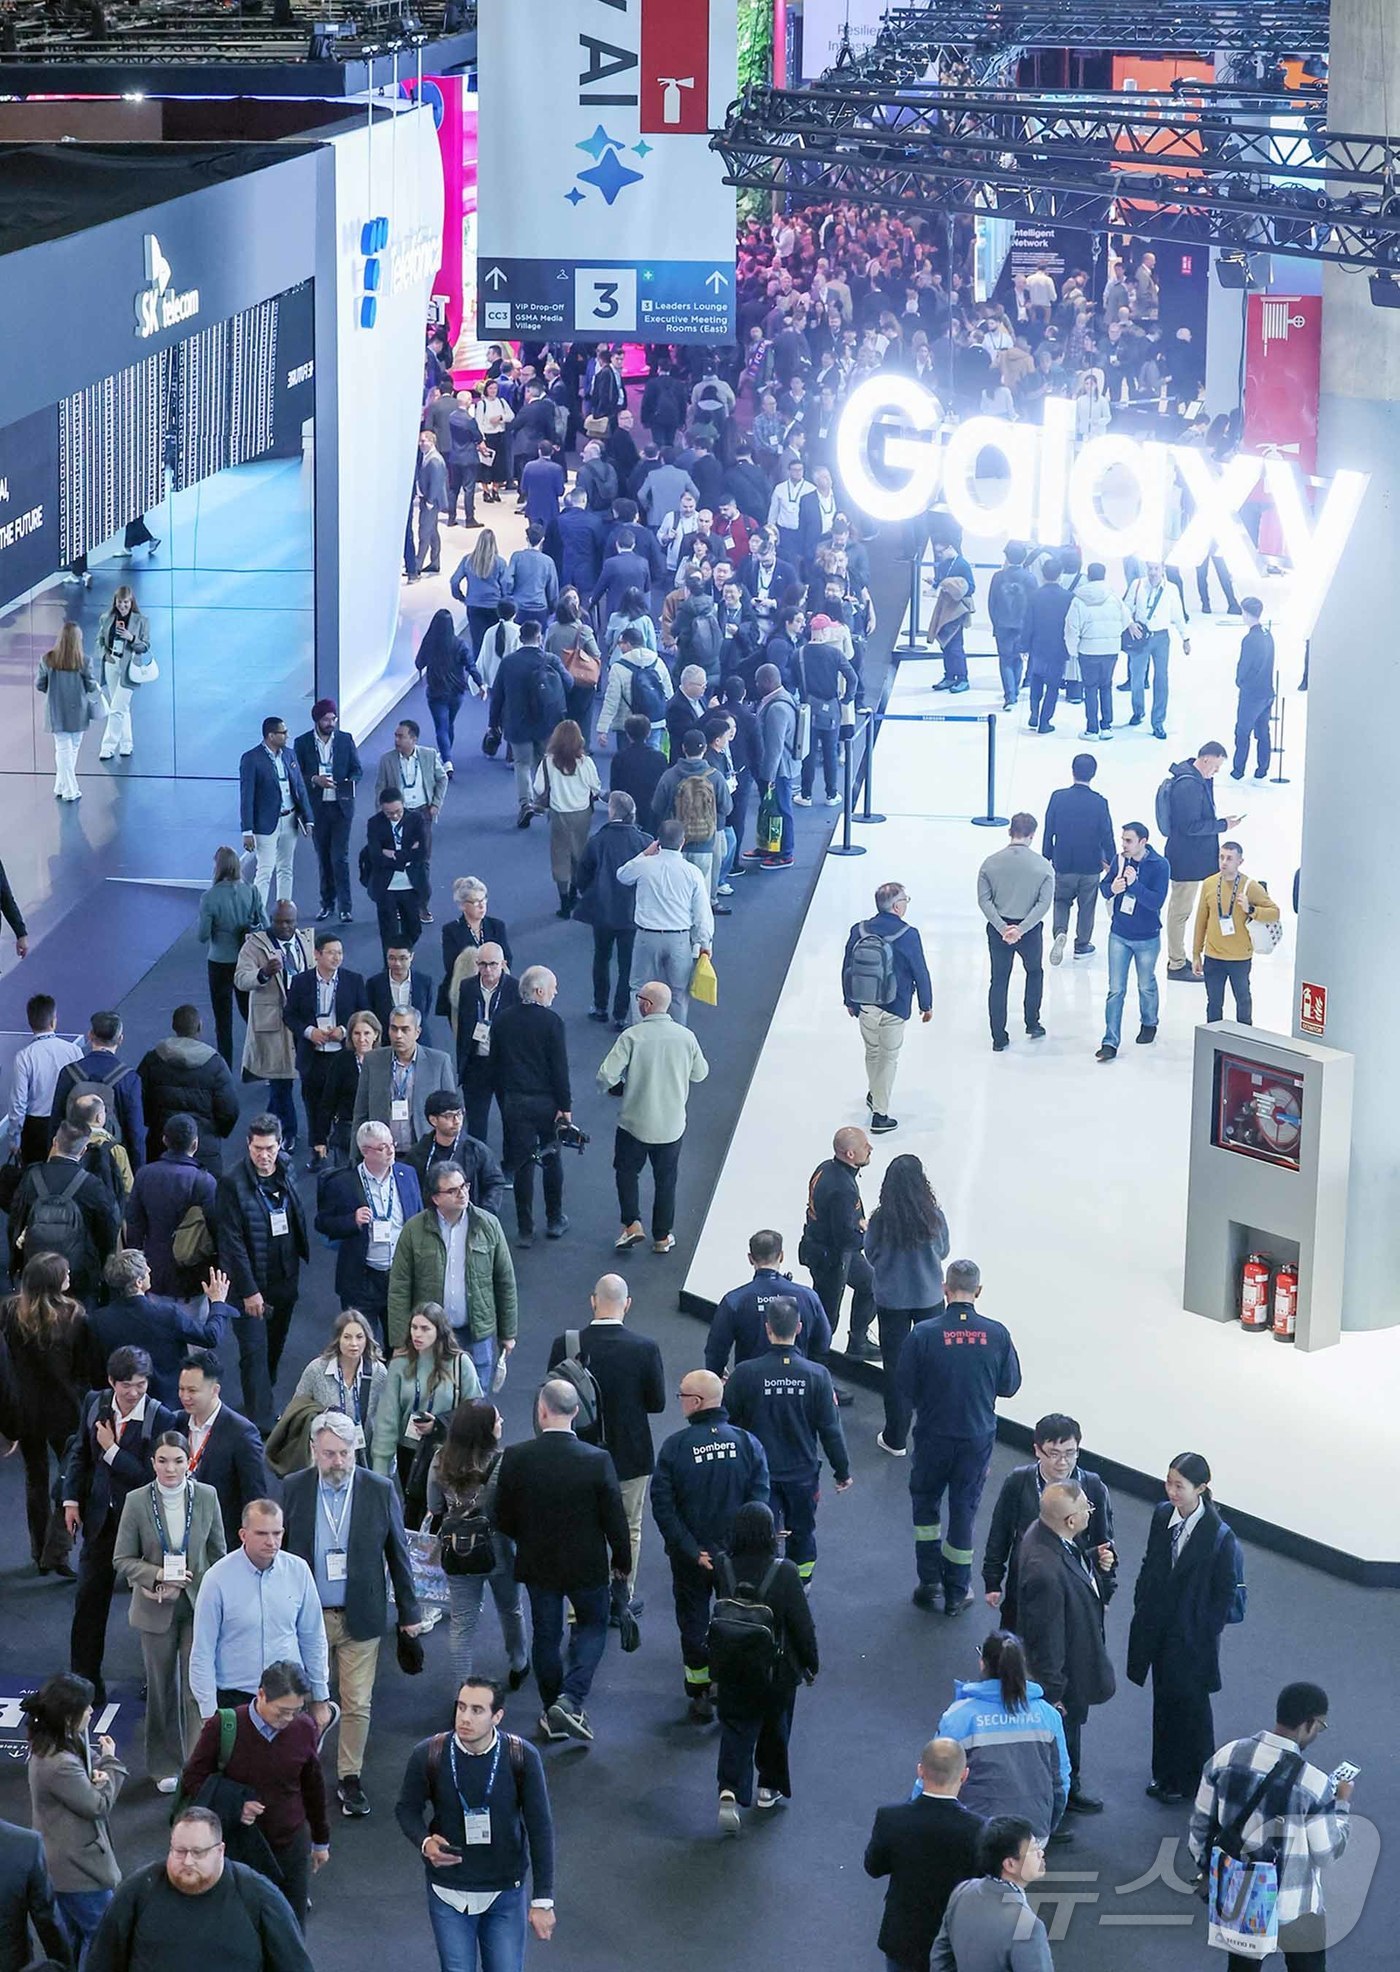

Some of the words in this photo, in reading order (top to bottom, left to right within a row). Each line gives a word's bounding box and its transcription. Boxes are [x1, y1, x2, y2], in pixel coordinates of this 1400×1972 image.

[579, 33, 638, 106] AI
[592, 282, 620, 320] 3
[515, 303, 529, 311] VIP
[531, 304, 565, 312] Drop-Off
[643, 302, 651, 311] 3
[655, 302, 691, 311] Leaders
[693, 303, 728, 313] Lounge
[138, 289, 159, 338] SK
[163, 289, 199, 328] telecom
[488, 311, 508, 320] CC3
[515, 314, 538, 322] GSMA
[540, 314, 563, 322] Media
[515, 322, 541, 330] Village
[644, 315, 689, 324] Executive
[691, 316, 728, 326] Meeting
[666, 325, 697, 333] Rooms
[699, 325, 728, 335] (East)
[836, 374, 1371, 641] Galaxy
[0, 522, 14, 549] THE
[15, 504, 43, 541] FUTURE
[943, 1330, 987, 1340] bombers
[764, 1378, 806, 1388] bombers
[692, 1441, 736, 1455] bombers
